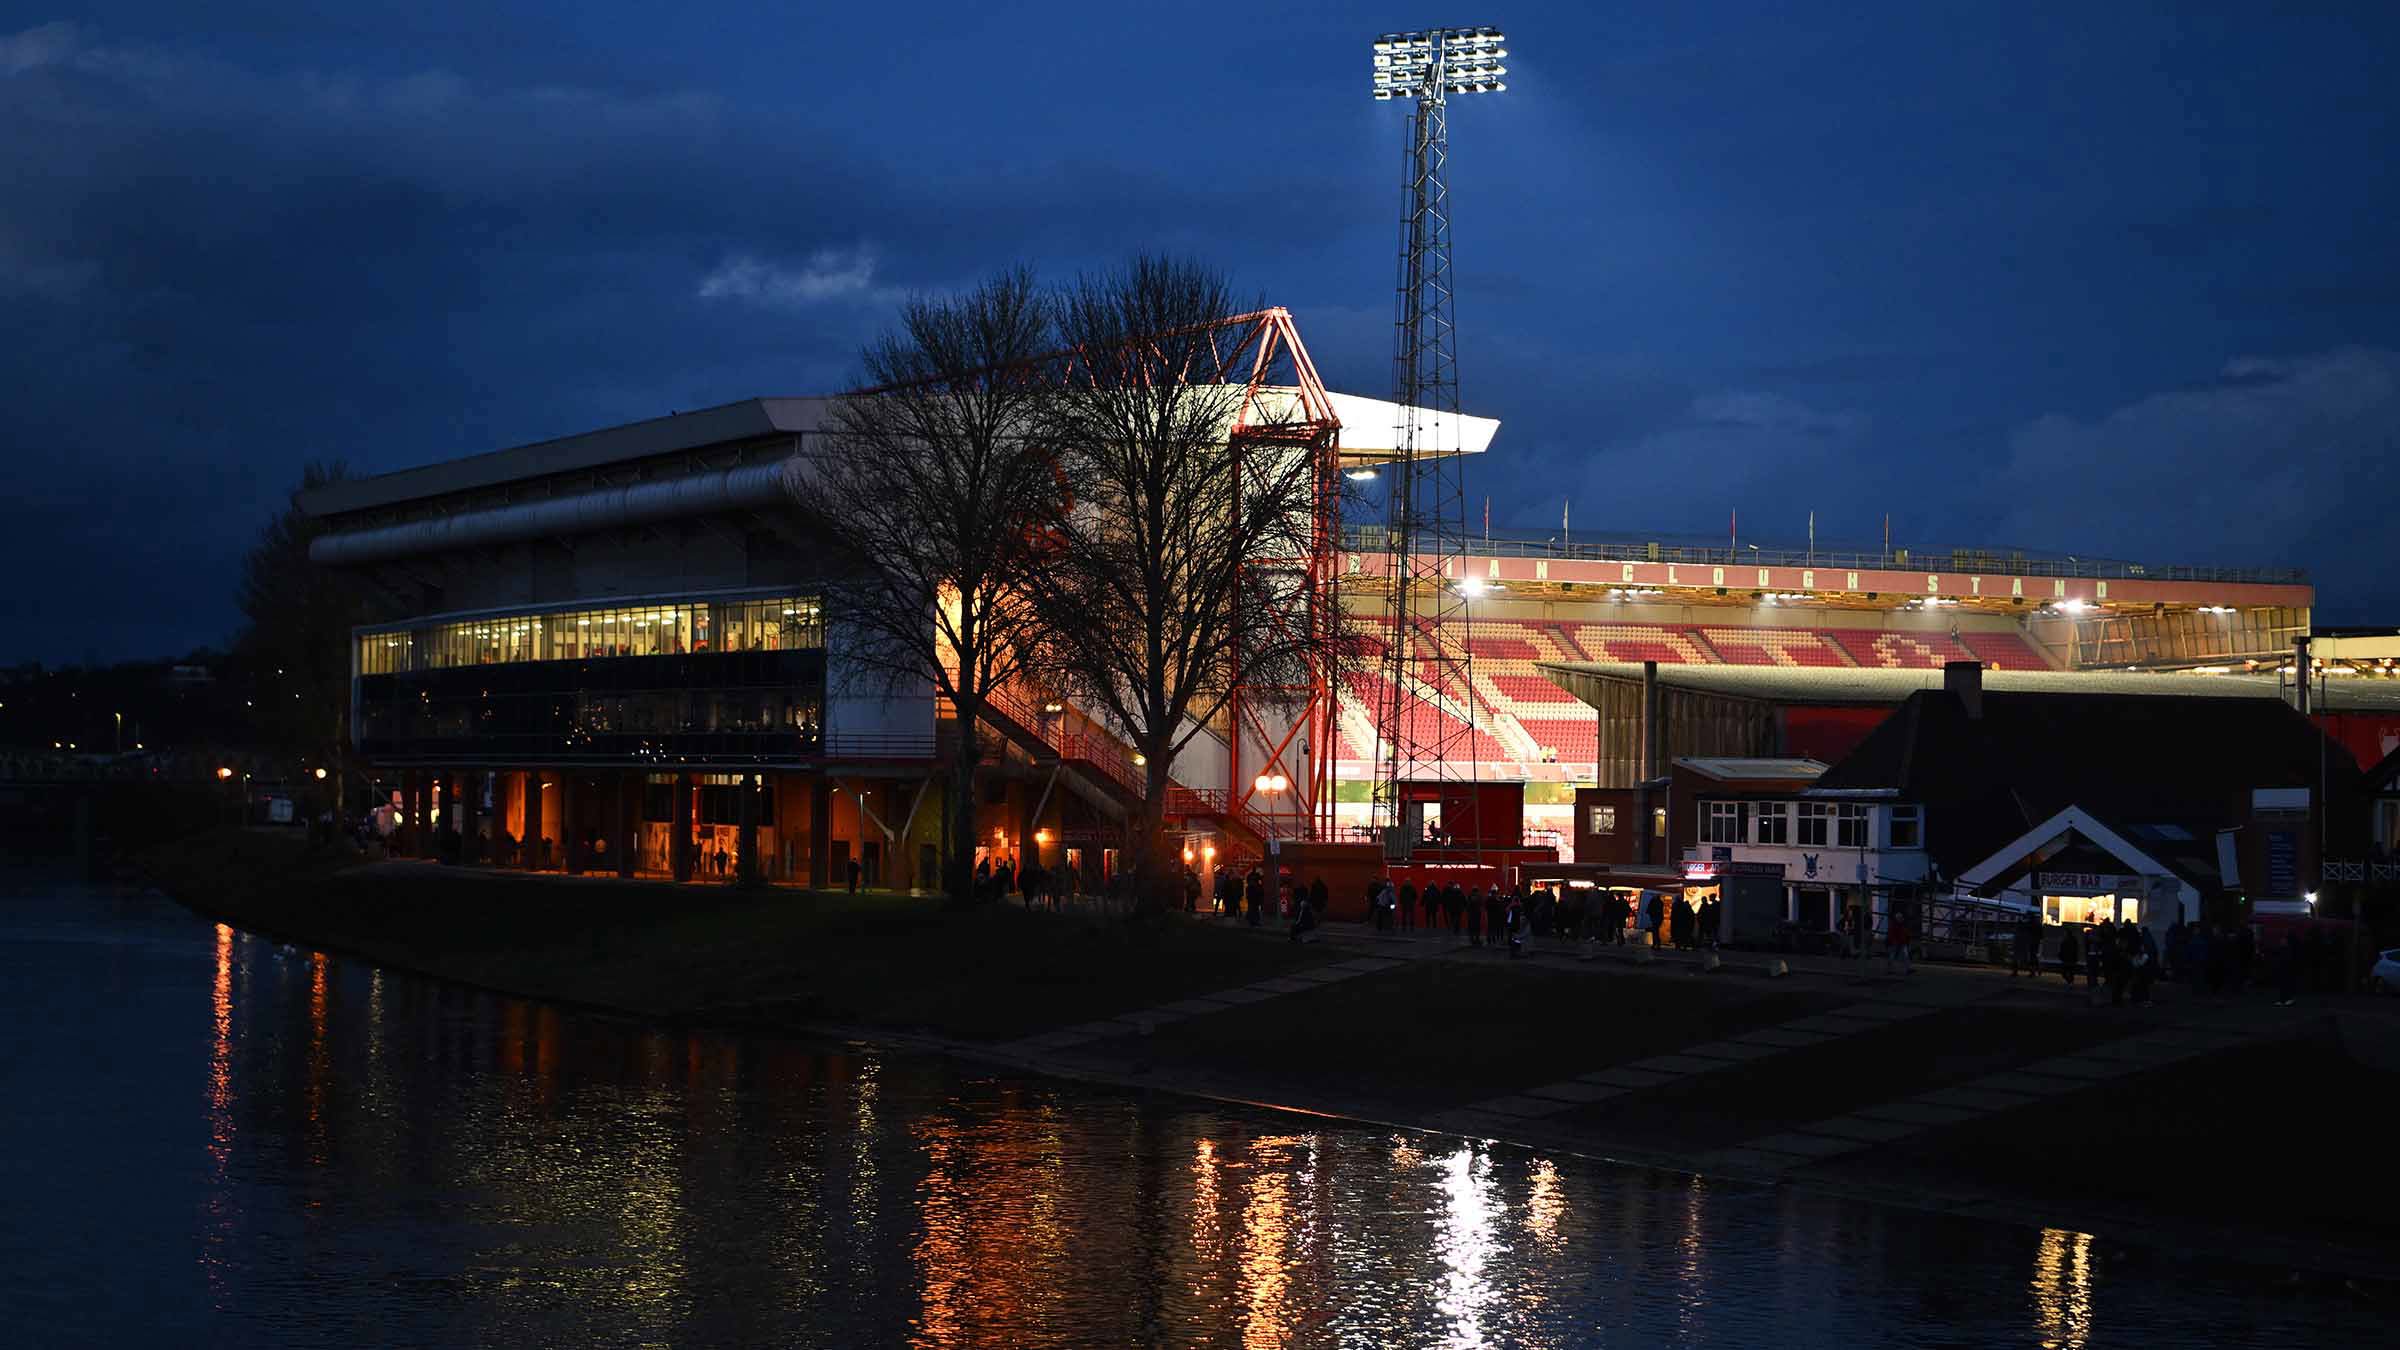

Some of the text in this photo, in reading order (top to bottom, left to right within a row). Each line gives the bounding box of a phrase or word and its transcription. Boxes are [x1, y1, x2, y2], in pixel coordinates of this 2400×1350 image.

[1622, 563, 1858, 589] CLOUGH
[1927, 574, 2108, 598] STAND
[2040, 872, 2077, 888] BURGER
[2080, 873, 2101, 888] BAR
